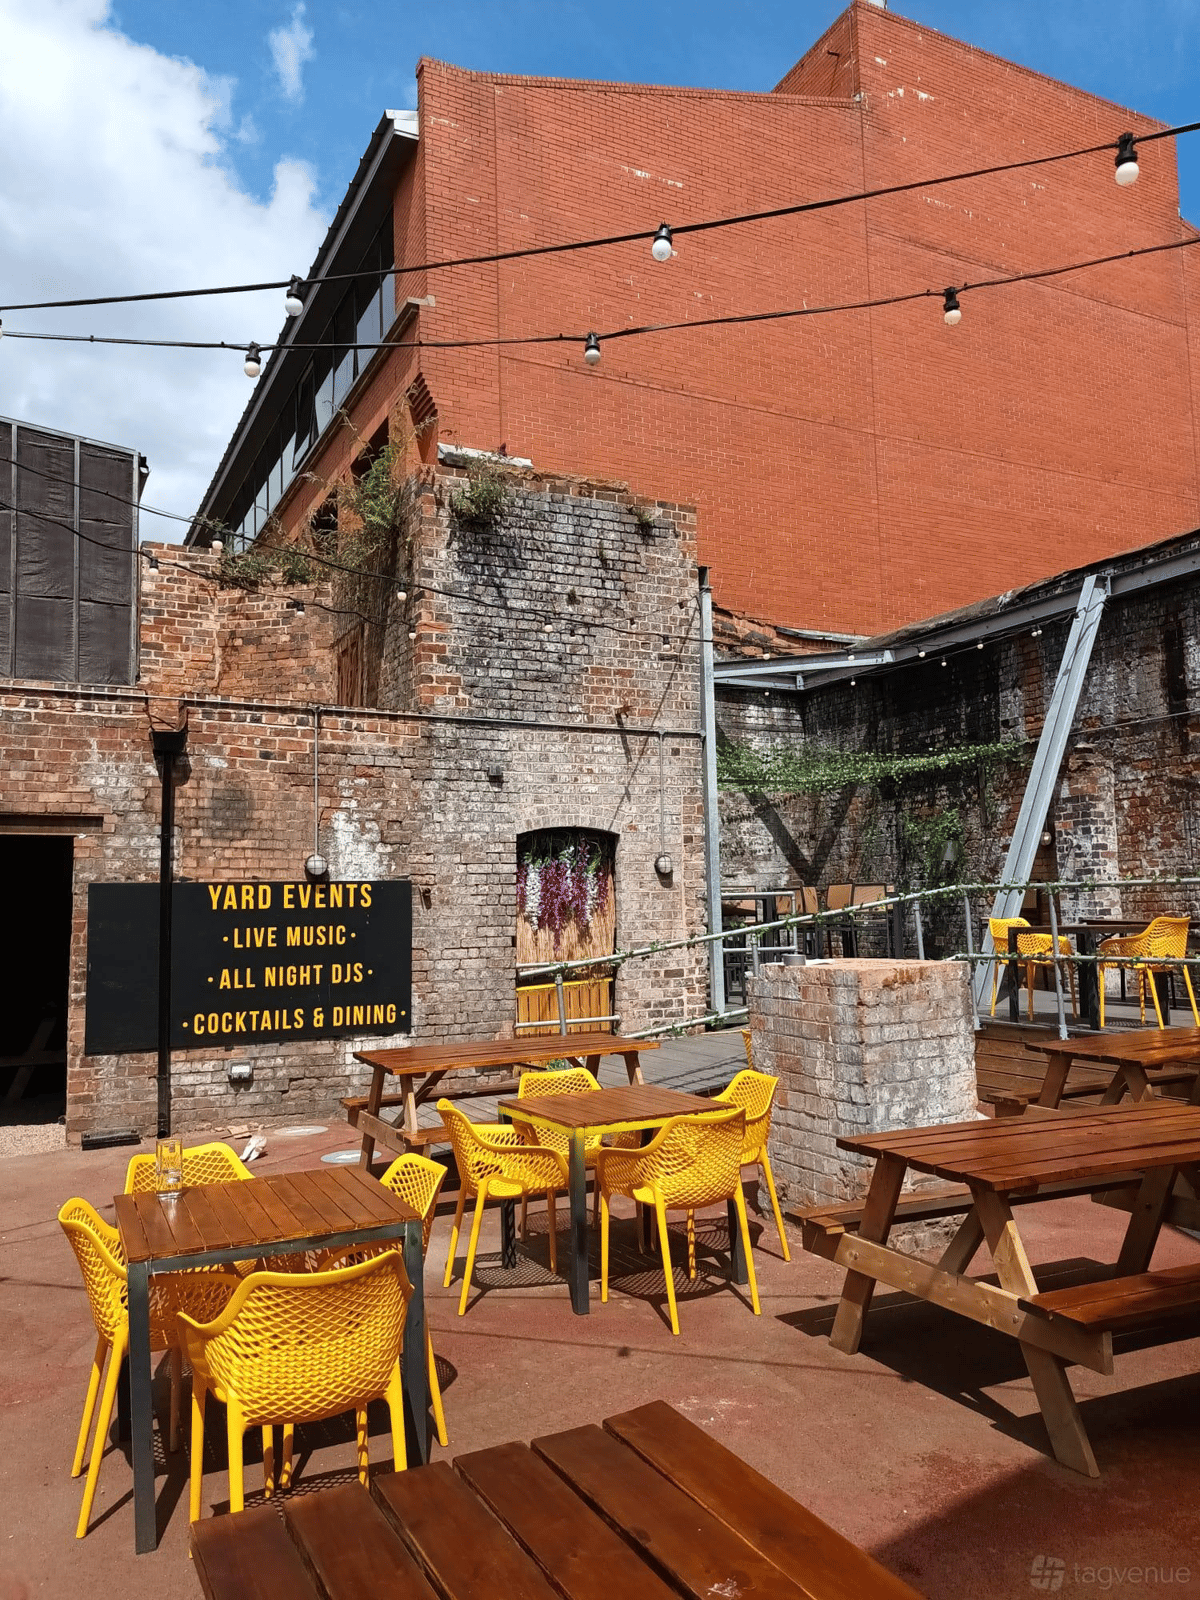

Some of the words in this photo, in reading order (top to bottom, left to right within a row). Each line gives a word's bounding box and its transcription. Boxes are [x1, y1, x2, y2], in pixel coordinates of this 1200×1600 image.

[208, 883, 272, 910] YARD
[283, 883, 373, 909] EVENTS
[233, 926, 278, 949] LIVE
[286, 924, 347, 947] MUSIC
[219, 967, 256, 990] ALL
[264, 964, 323, 988] NIGHT
[331, 962, 364, 984] DJS
[193, 1007, 305, 1035] COCKTAILS
[312, 1007, 325, 1028] &
[332, 1003, 397, 1027] DINING
